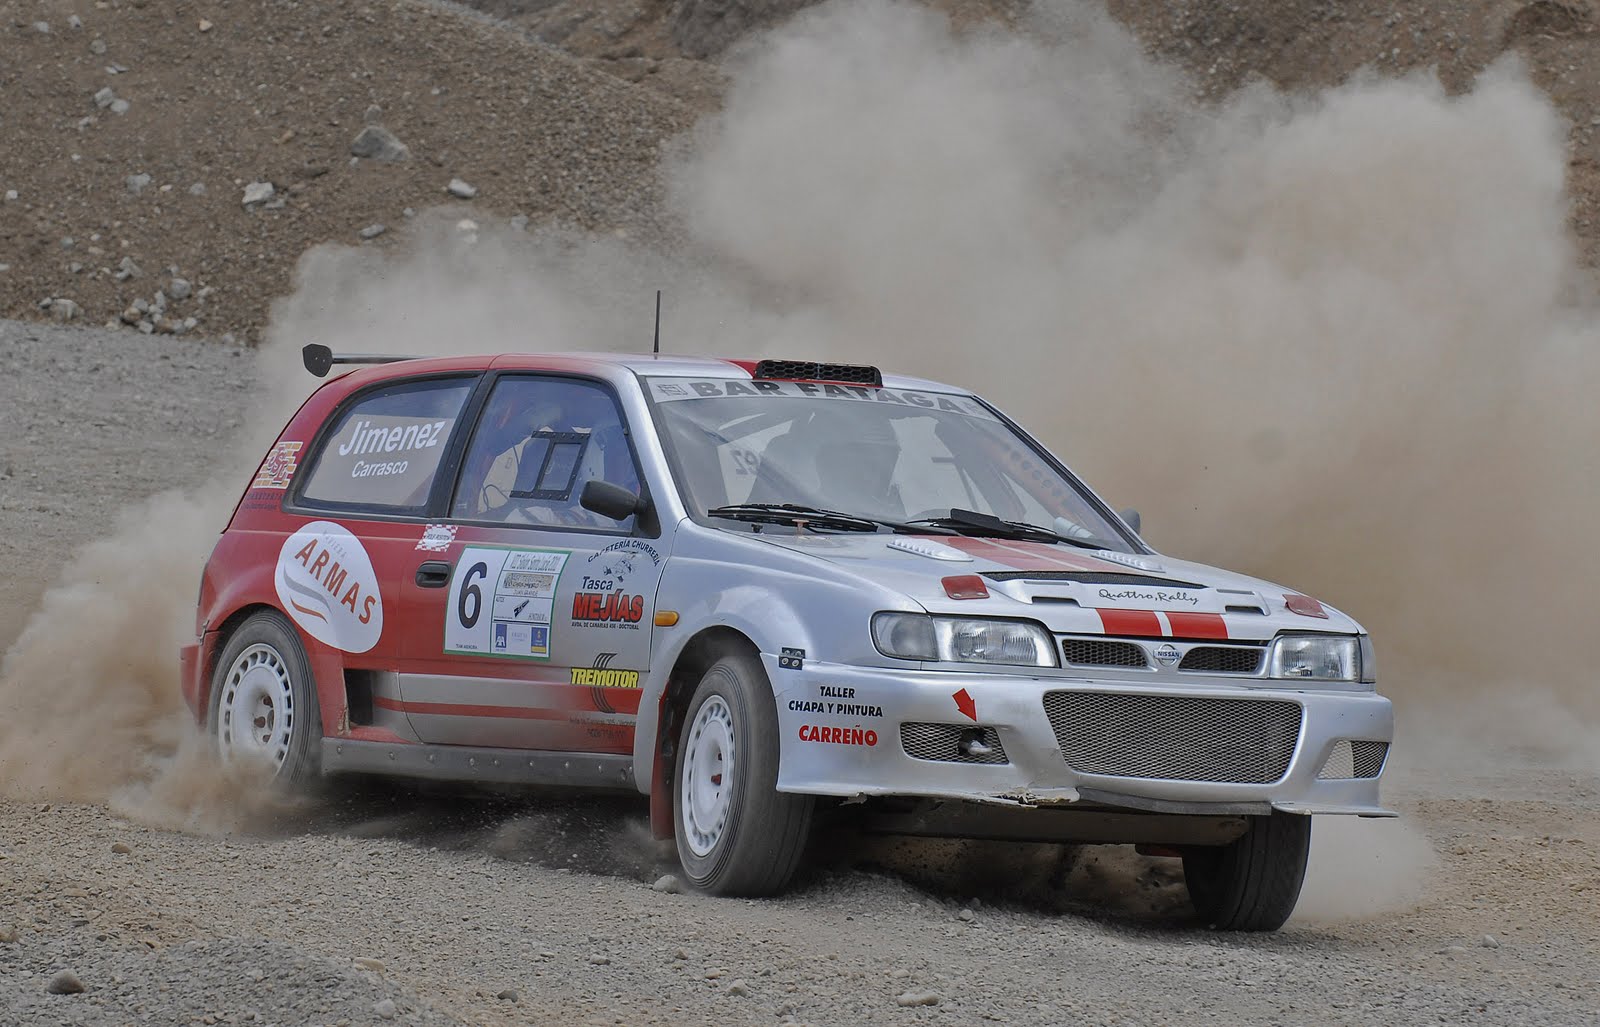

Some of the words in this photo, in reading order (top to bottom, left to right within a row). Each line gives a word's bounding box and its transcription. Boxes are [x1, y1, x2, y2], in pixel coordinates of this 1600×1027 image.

[689, 381, 787, 397] BAR
[794, 382, 969, 415] FATAGA
[339, 420, 446, 456] Jimenez
[351, 460, 408, 478] Carrasco
[294, 538, 376, 625] ARMAS
[582, 575, 614, 591] Tasca
[458, 561, 488, 629] 6
[572, 588, 644, 623] MEJÍAS
[1157, 650, 1180, 658] NISSAN
[571, 667, 639, 688] TREMOTOR
[820, 685, 855, 699] TALLER
[788, 700, 825, 714] CHAPA
[827, 702, 835, 714] Y
[836, 703, 884, 718] PINTURA
[798, 724, 878, 747] CARREÑO
